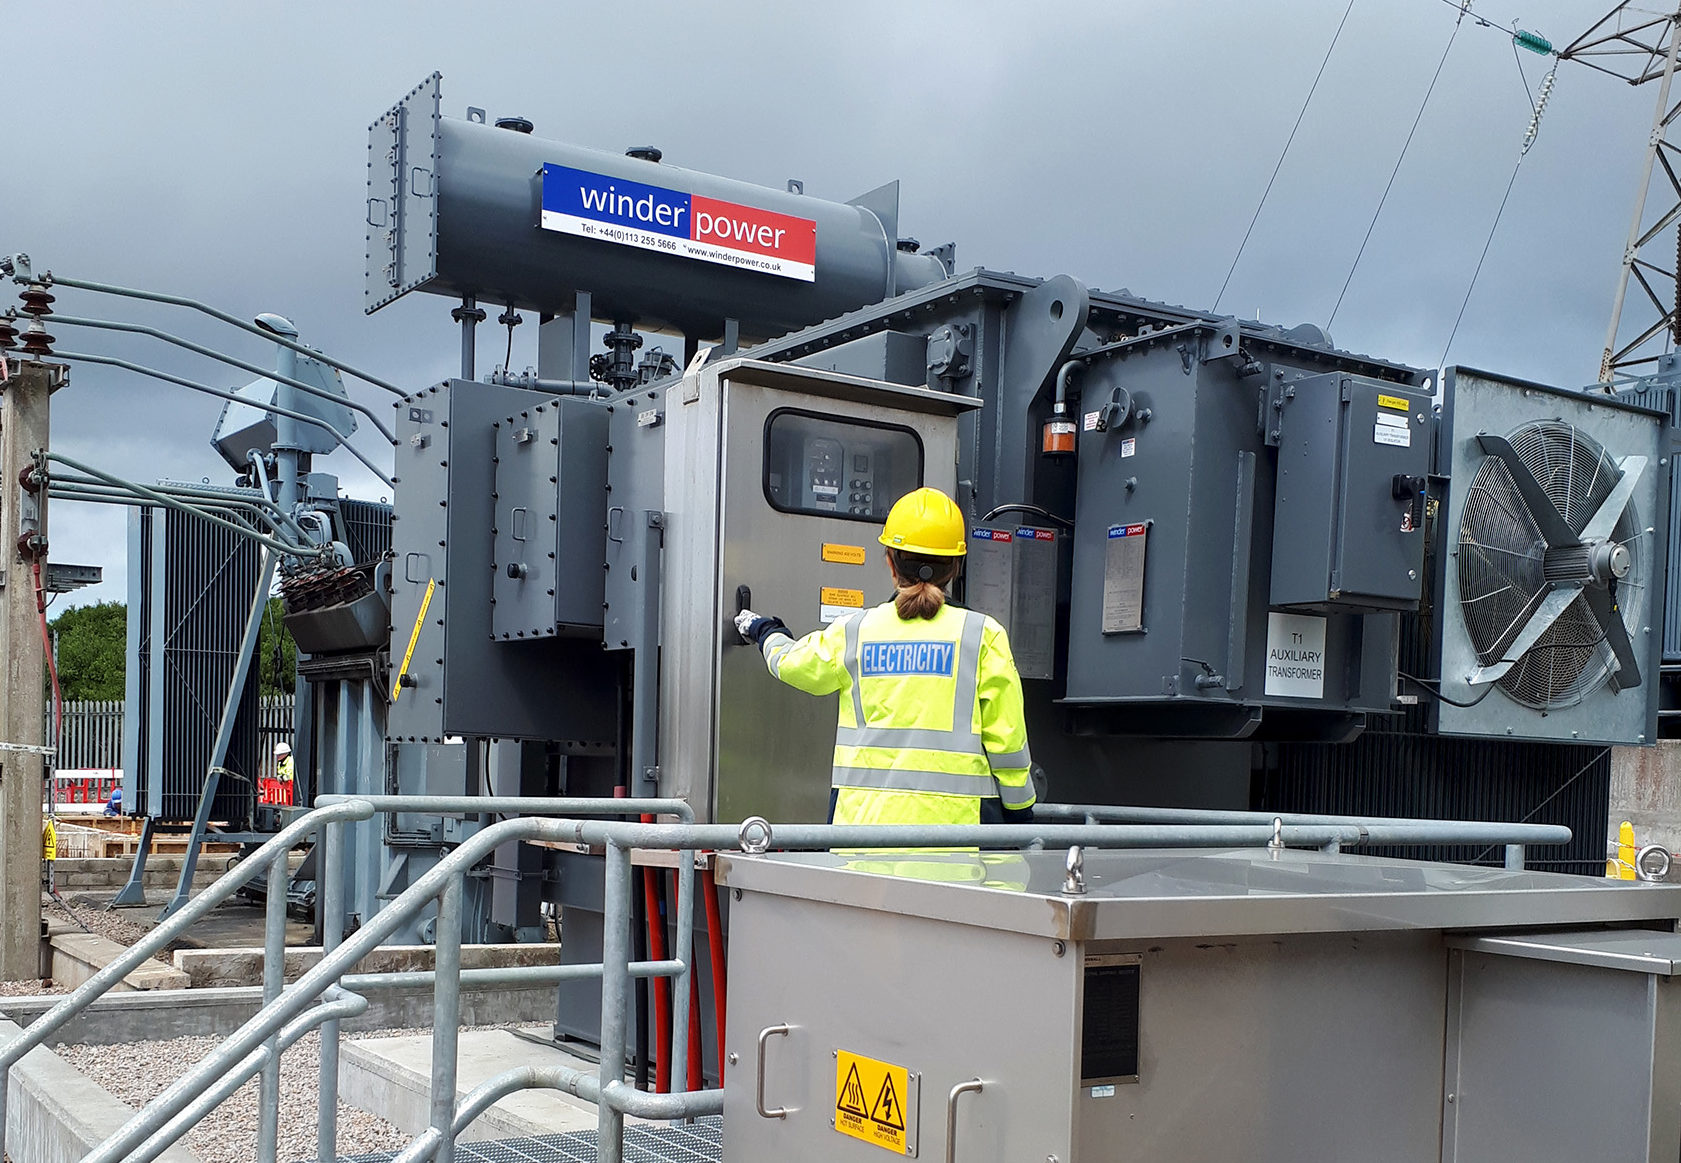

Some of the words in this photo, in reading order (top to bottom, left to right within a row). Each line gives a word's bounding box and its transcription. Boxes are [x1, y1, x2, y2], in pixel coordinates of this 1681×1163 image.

[580, 185, 686, 228] winder
[695, 210, 786, 249] power
[581, 223, 596, 235] Tel:
[598, 228, 639, 243] +44(0)113
[641, 235, 656, 246] 255
[657, 239, 677, 251] 5666
[687, 245, 782, 272] www.winderpower.co.uk
[993, 532, 1010, 540] power
[1127, 526, 1143, 535] power
[1292, 633, 1303, 645] T1
[863, 643, 951, 673] ELECTRICITY
[1270, 649, 1322, 663] AUXILIARY
[1268, 665, 1322, 680] TRANSFORMER
[843, 1112, 862, 1125] DANGER
[877, 1124, 898, 1137] DANGER
[883, 1134, 901, 1146] VOLTAGE
